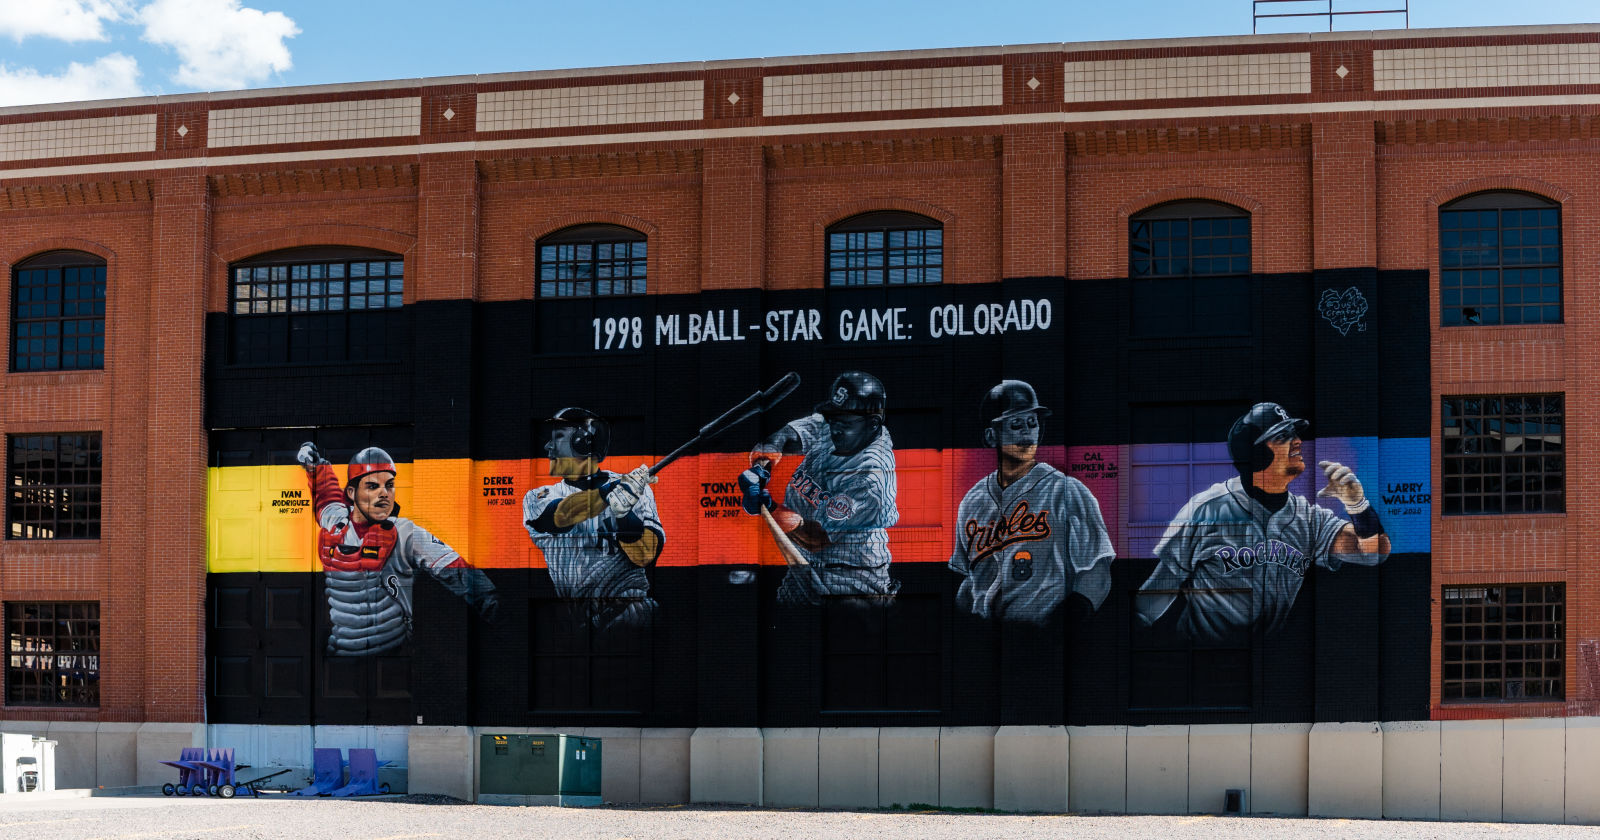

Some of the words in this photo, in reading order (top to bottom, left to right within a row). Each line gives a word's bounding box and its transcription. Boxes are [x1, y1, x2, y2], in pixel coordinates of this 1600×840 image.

[592, 316, 643, 350] 1998
[839, 307, 913, 342] GAME:
[929, 298, 1052, 339] COLORADO
[1083, 452, 1104, 462] CAL
[1071, 463, 1105, 472] RIPKEN
[483, 476, 514, 486] DEREK
[483, 487, 514, 497] JETER
[701, 482, 737, 494] TONY
[1387, 482, 1424, 493] LARRY
[281, 490, 302, 499] IVAN
[1382, 494, 1432, 505] WALKER
[271, 499, 310, 507] RODRIGUEZ
[487, 498, 499, 506] HOF
[700, 496, 742, 508] GWYNN
[704, 510, 720, 518] HOF
[722, 509, 740, 518] 2007
[1386, 507, 1402, 516] HOF
[1215, 539, 1312, 577] ROCKIES
[1012, 550, 1033, 581] 8
